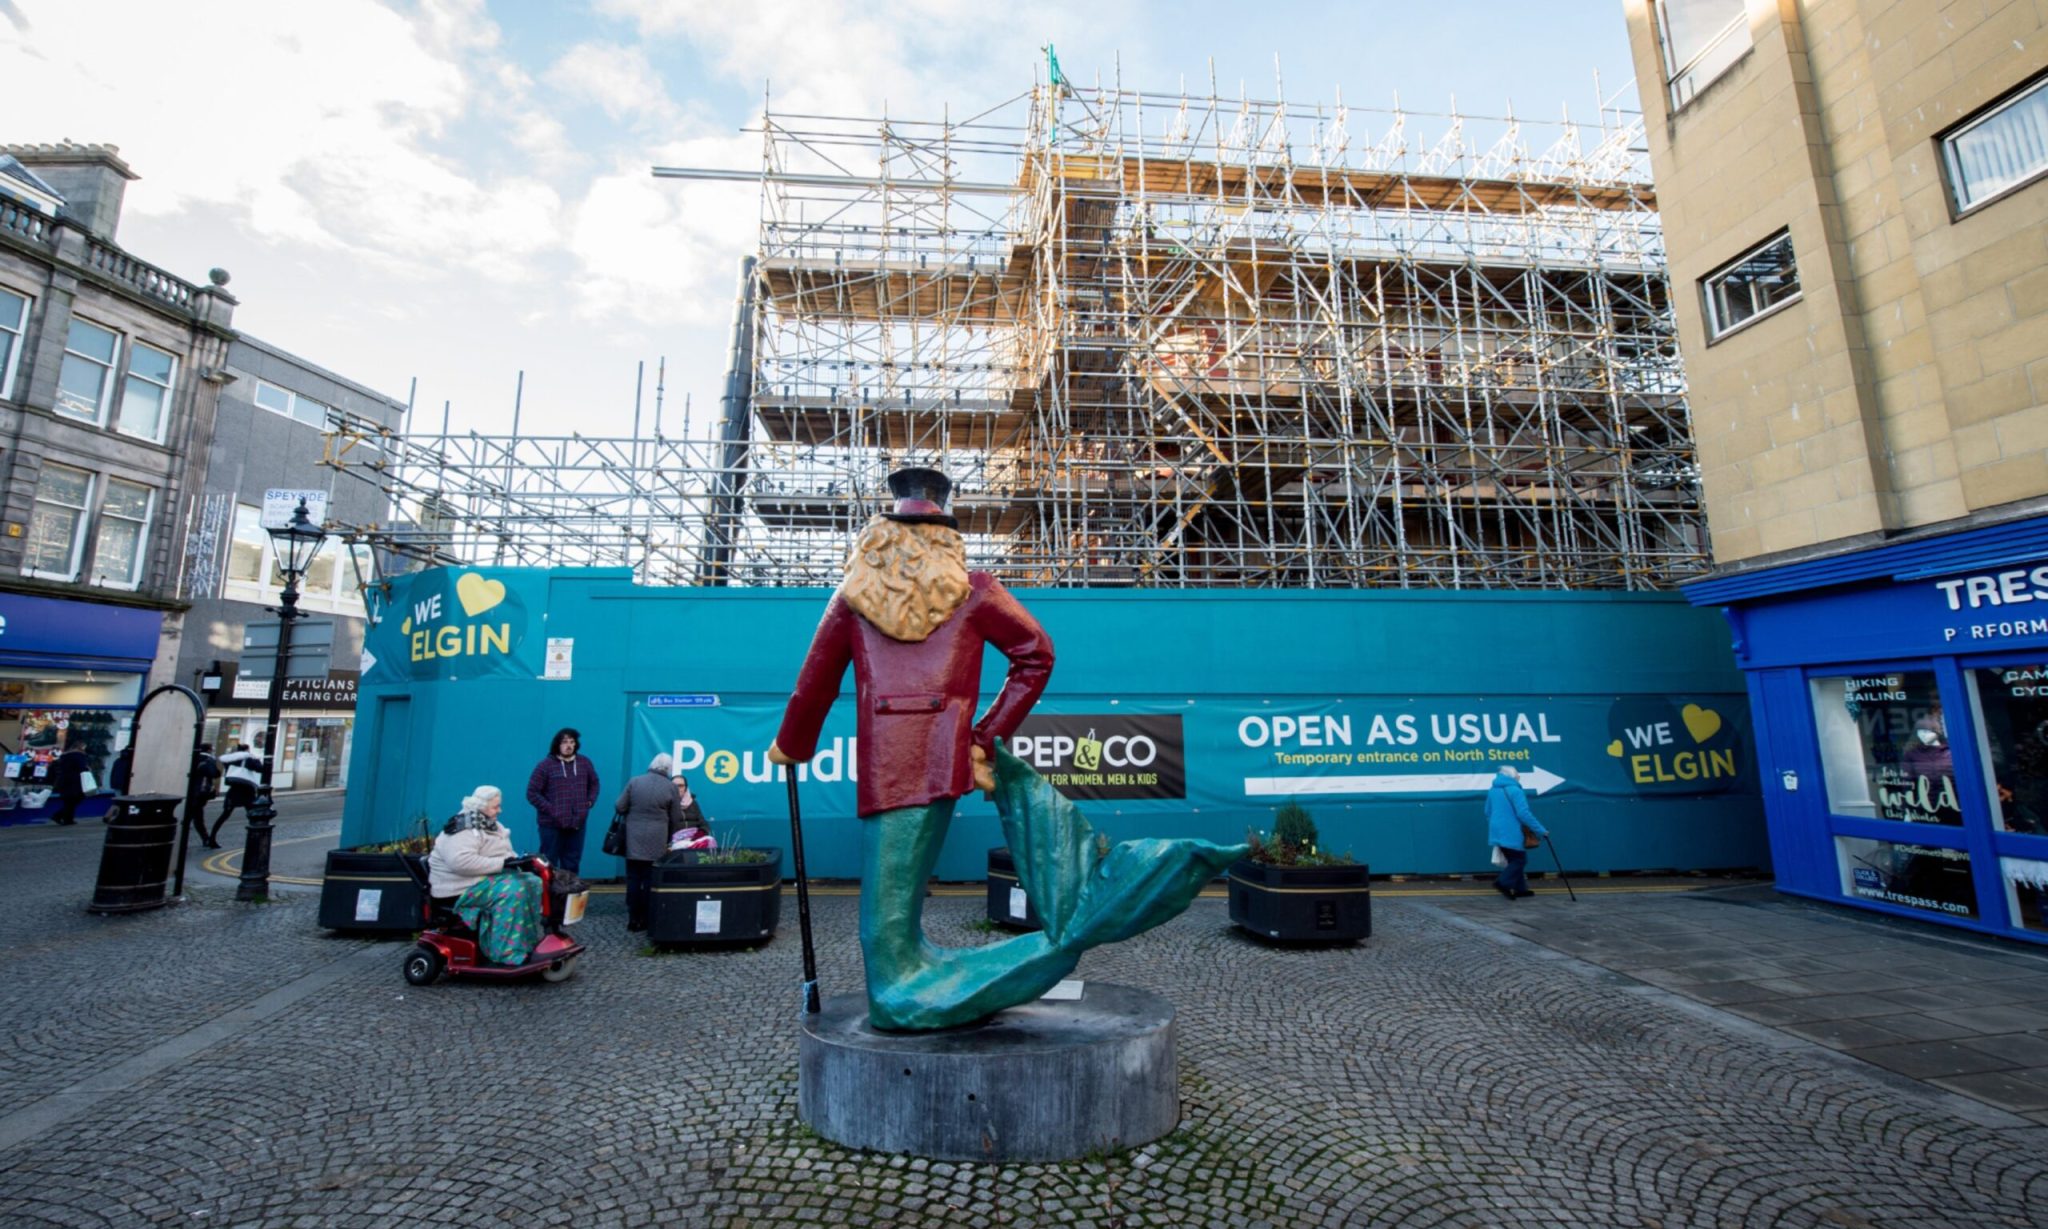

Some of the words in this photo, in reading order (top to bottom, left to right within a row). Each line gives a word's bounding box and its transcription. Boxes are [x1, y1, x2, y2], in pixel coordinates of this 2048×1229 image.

[266, 490, 325, 501] SPEYSIDE
[414, 593, 442, 625] WE
[1944, 618, 2048, 641] PRFORM
[411, 623, 511, 662] ELGIN
[286, 679, 354, 690] PTICIANS
[1844, 677, 1899, 689] HIKING
[282, 690, 331, 702] EARING
[334, 692, 357, 702] CAR
[1844, 691, 1907, 701] SAILING
[1238, 715, 1352, 747] OPEN
[1366, 714, 1418, 745] AS
[1431, 713, 1561, 745] USUAL
[1624, 722, 1674, 749] WE
[1275, 752, 1352, 766] Temporary
[1357, 751, 1419, 763] entrance
[1423, 753, 1441, 762] on
[1444, 749, 1484, 761] North
[1488, 748, 1530, 761] Street
[1631, 749, 1736, 783] ELGIN
[1051, 774, 1069, 785] FOR
[1108, 773, 1127, 785] MEN
[1128, 774, 1135, 784] &
[1137, 773, 1158, 785] KIDS
[1878, 774, 1962, 813] wild
[1857, 887, 1969, 914] www.trespass.com
